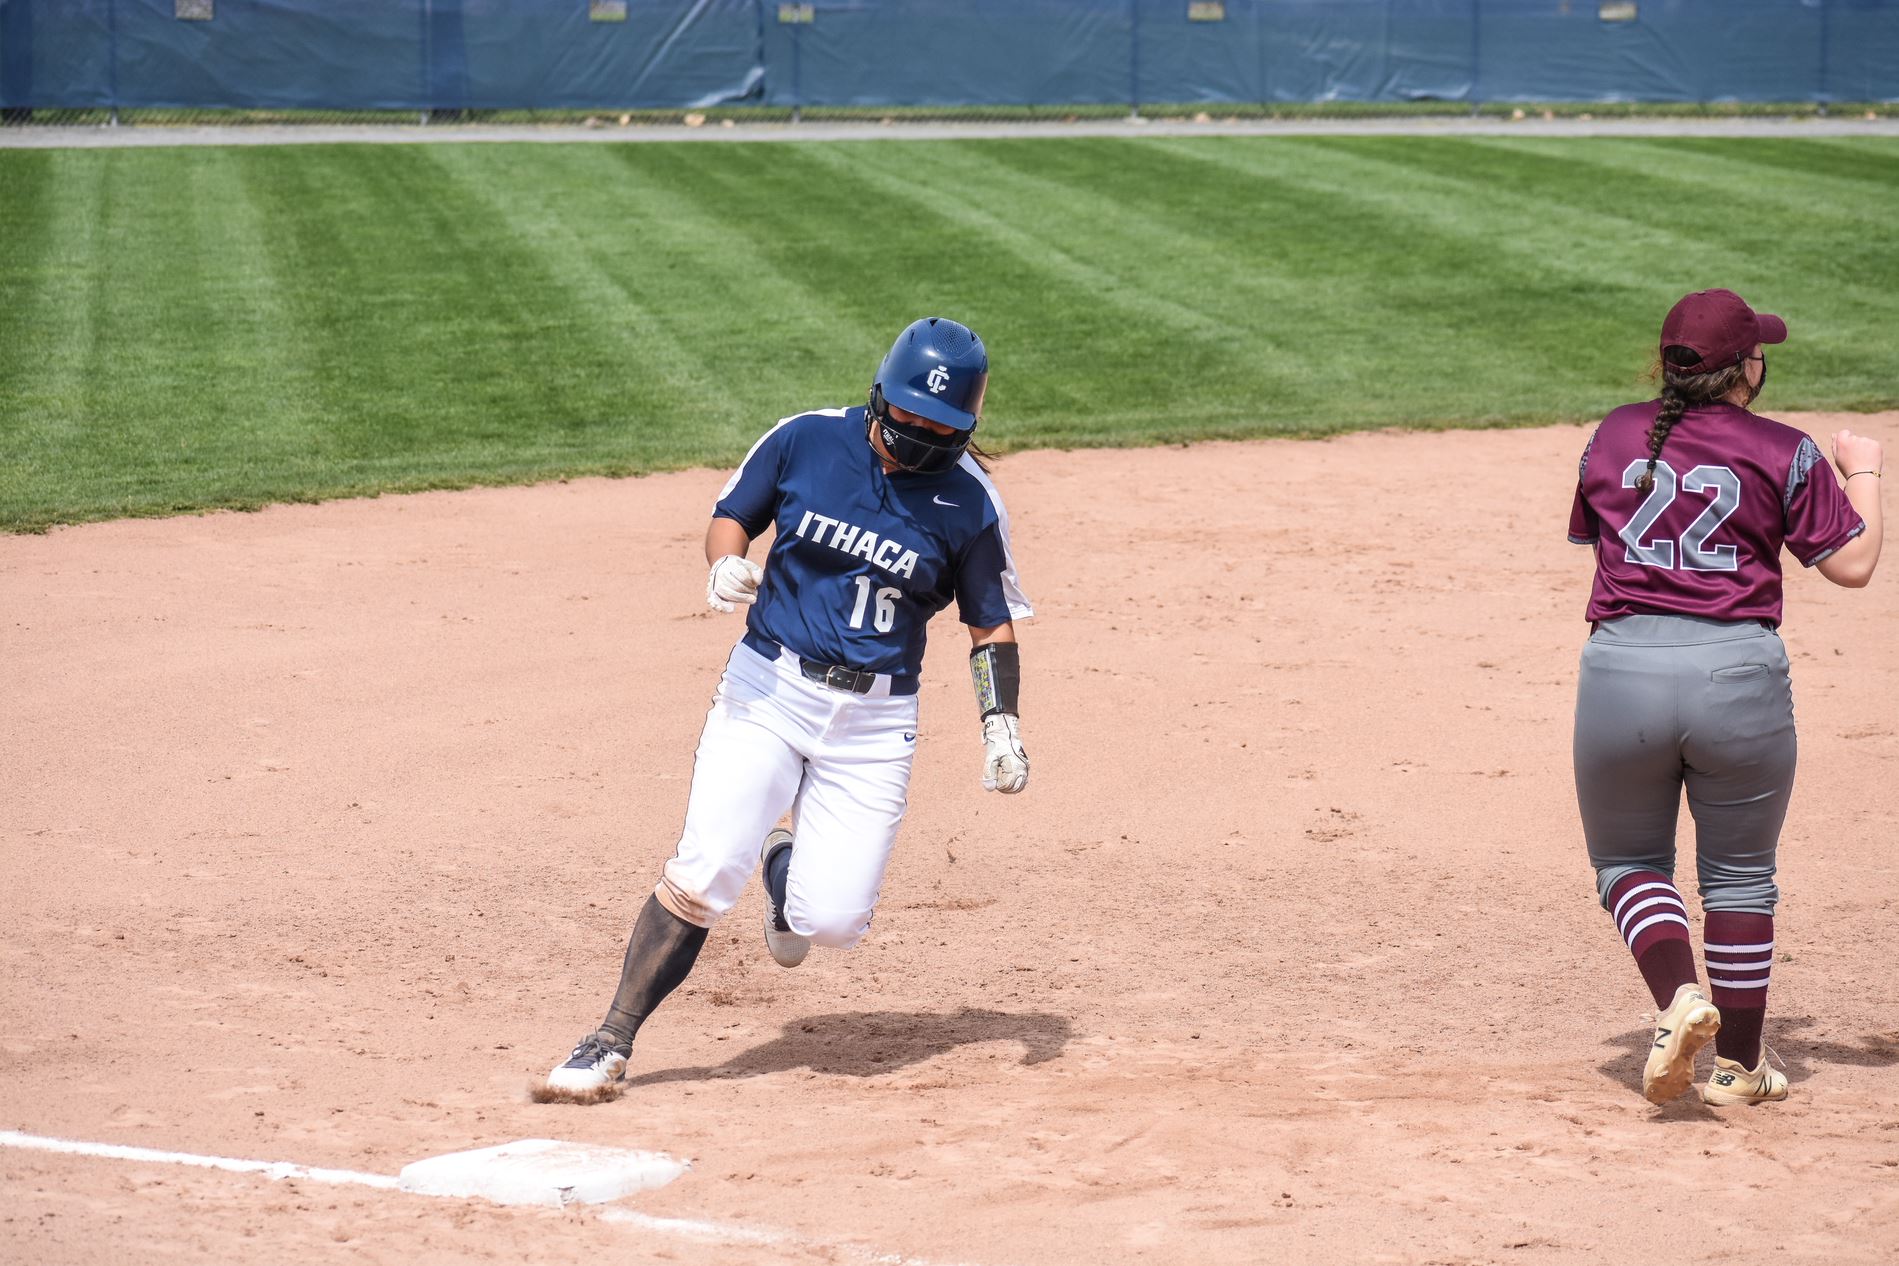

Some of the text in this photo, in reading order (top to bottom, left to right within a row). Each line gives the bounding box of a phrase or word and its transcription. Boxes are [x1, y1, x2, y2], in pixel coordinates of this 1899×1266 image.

[796, 510, 919, 580] ITHACA
[1618, 459, 1740, 571] 22
[849, 576, 903, 633] 16
